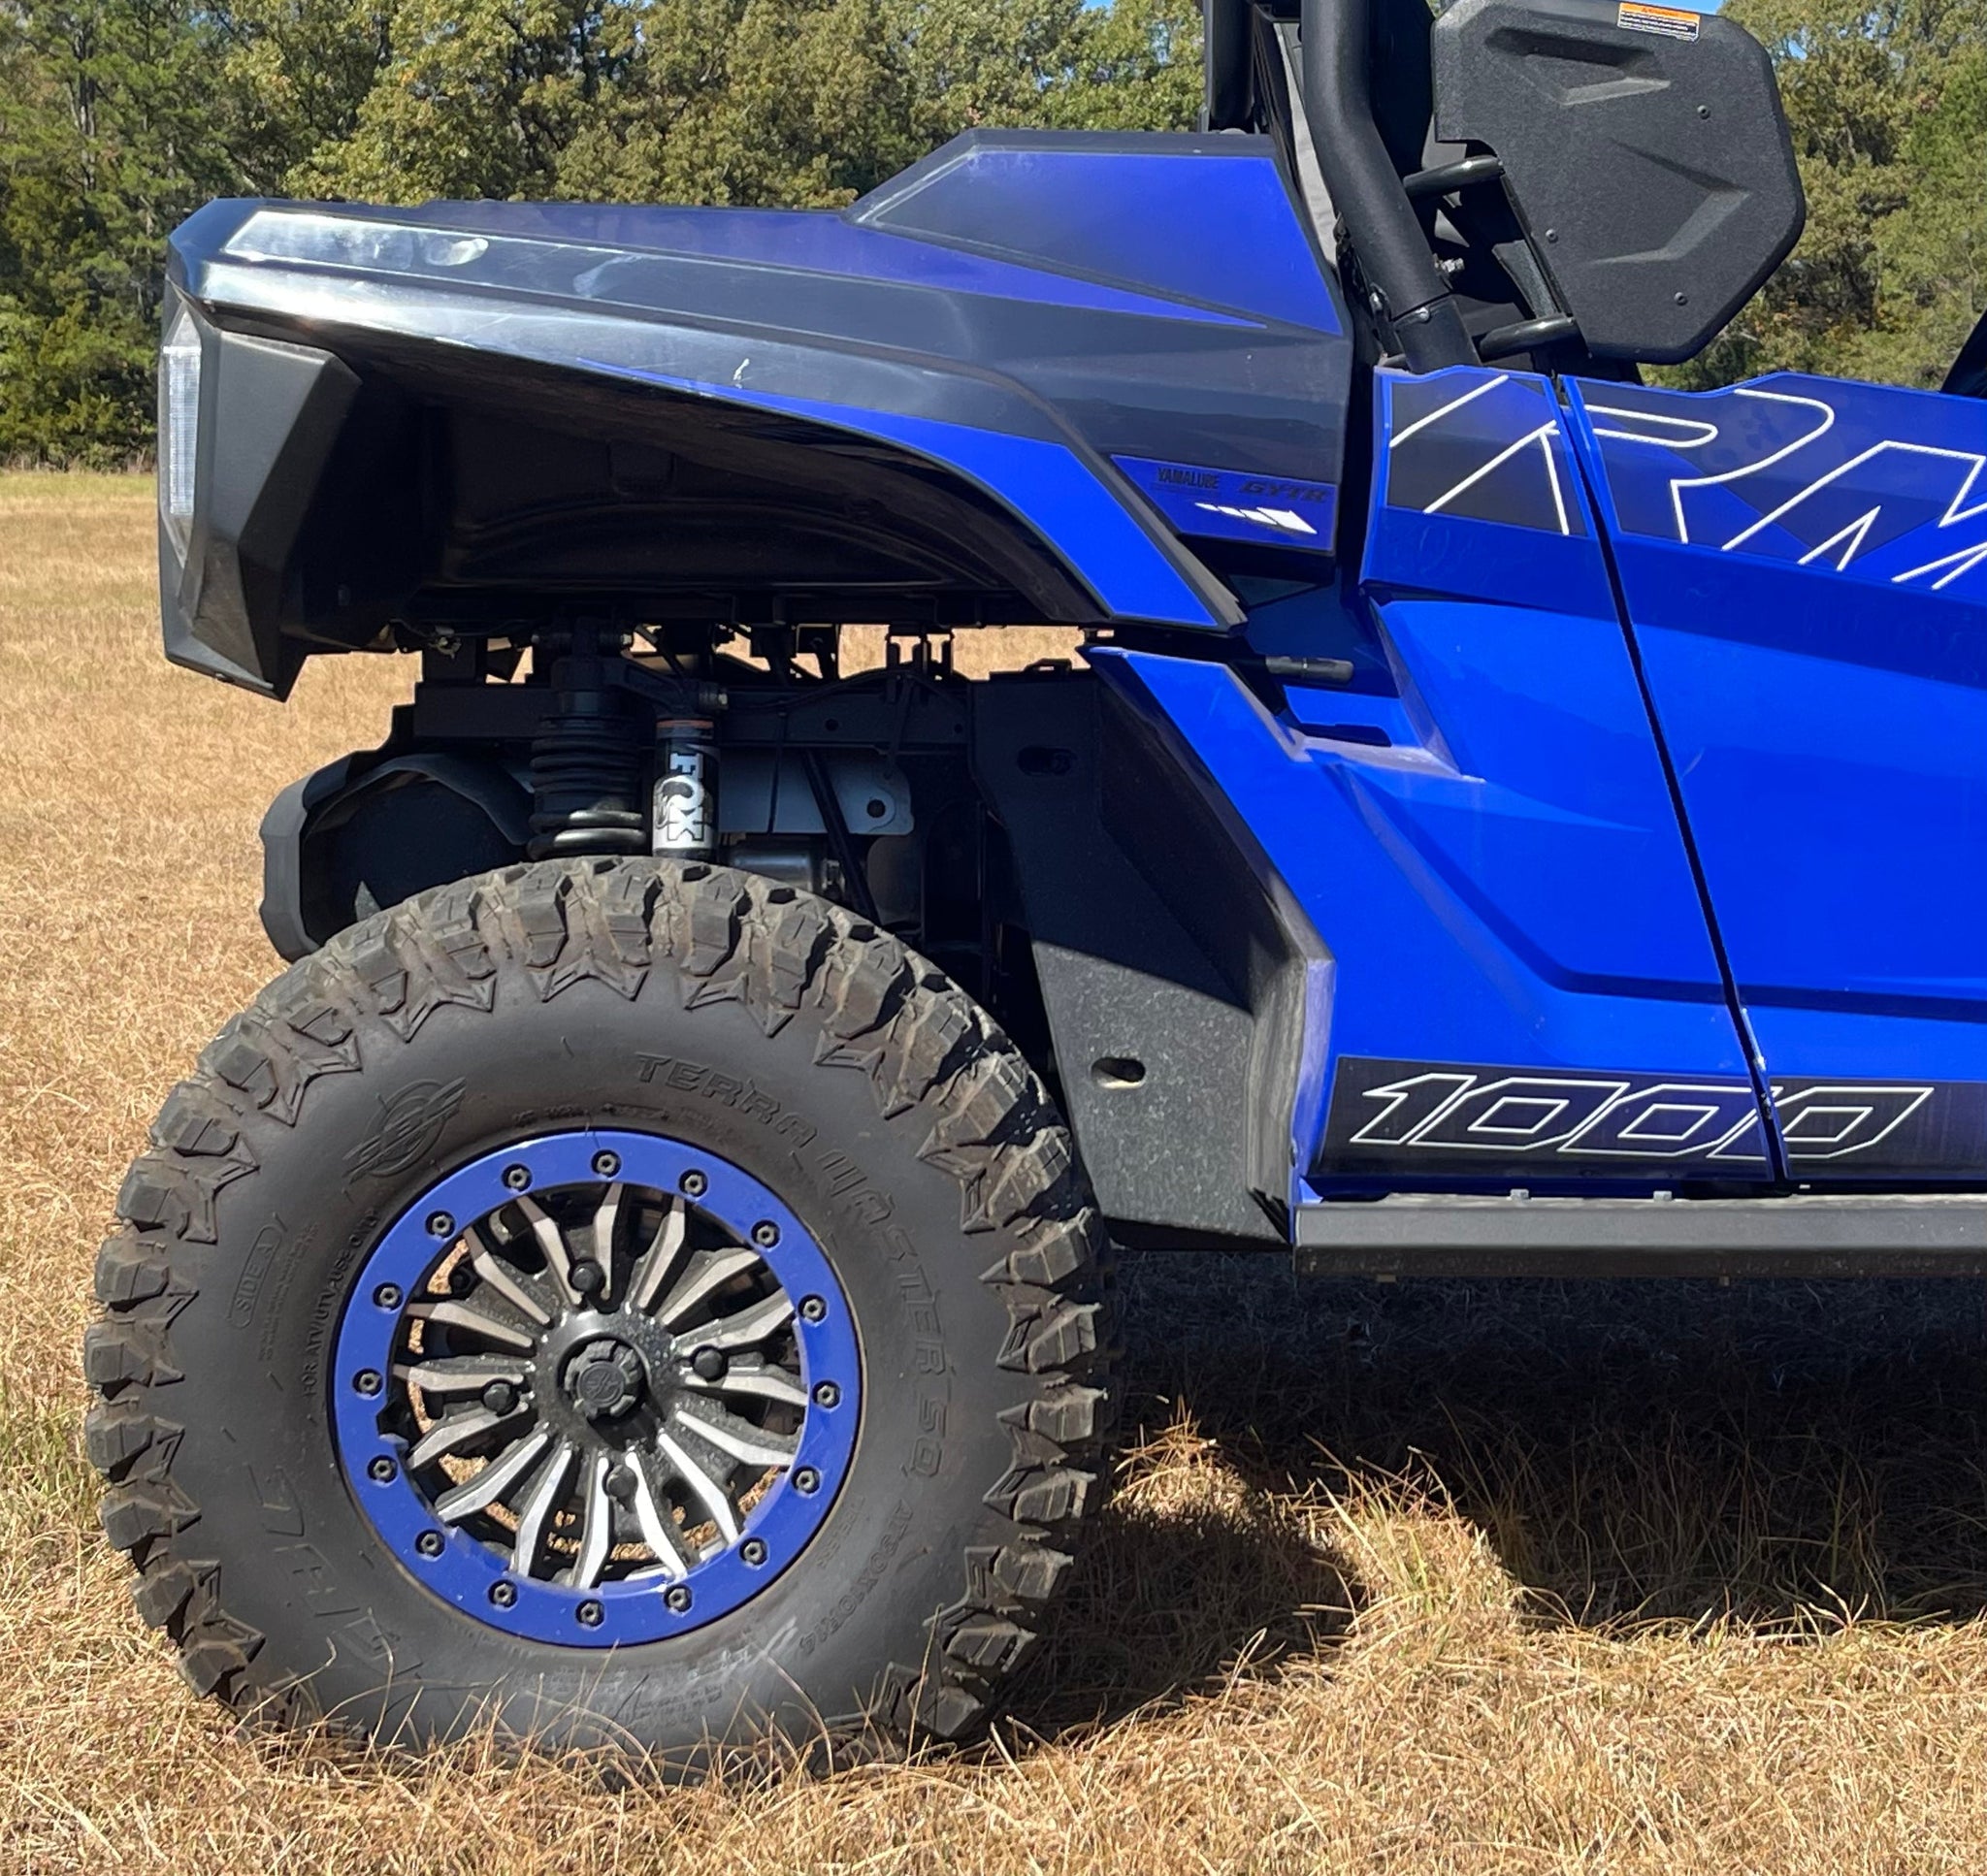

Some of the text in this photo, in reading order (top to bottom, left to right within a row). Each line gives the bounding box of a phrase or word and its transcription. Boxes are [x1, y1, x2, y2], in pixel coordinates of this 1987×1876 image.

[1157, 467, 1220, 490] YAMALUBE
[1239, 480, 1330, 503] GYTR
[660, 752, 705, 842] FOX
[1350, 1073, 1934, 1160] 1000
[635, 1051, 818, 1148] TERRA
[817, 1148, 944, 1375] MASTER
[237, 1239, 275, 1313] SIDE A
[302, 1362, 317, 1394] FOR
[350, 1209, 381, 1247] ONLY
